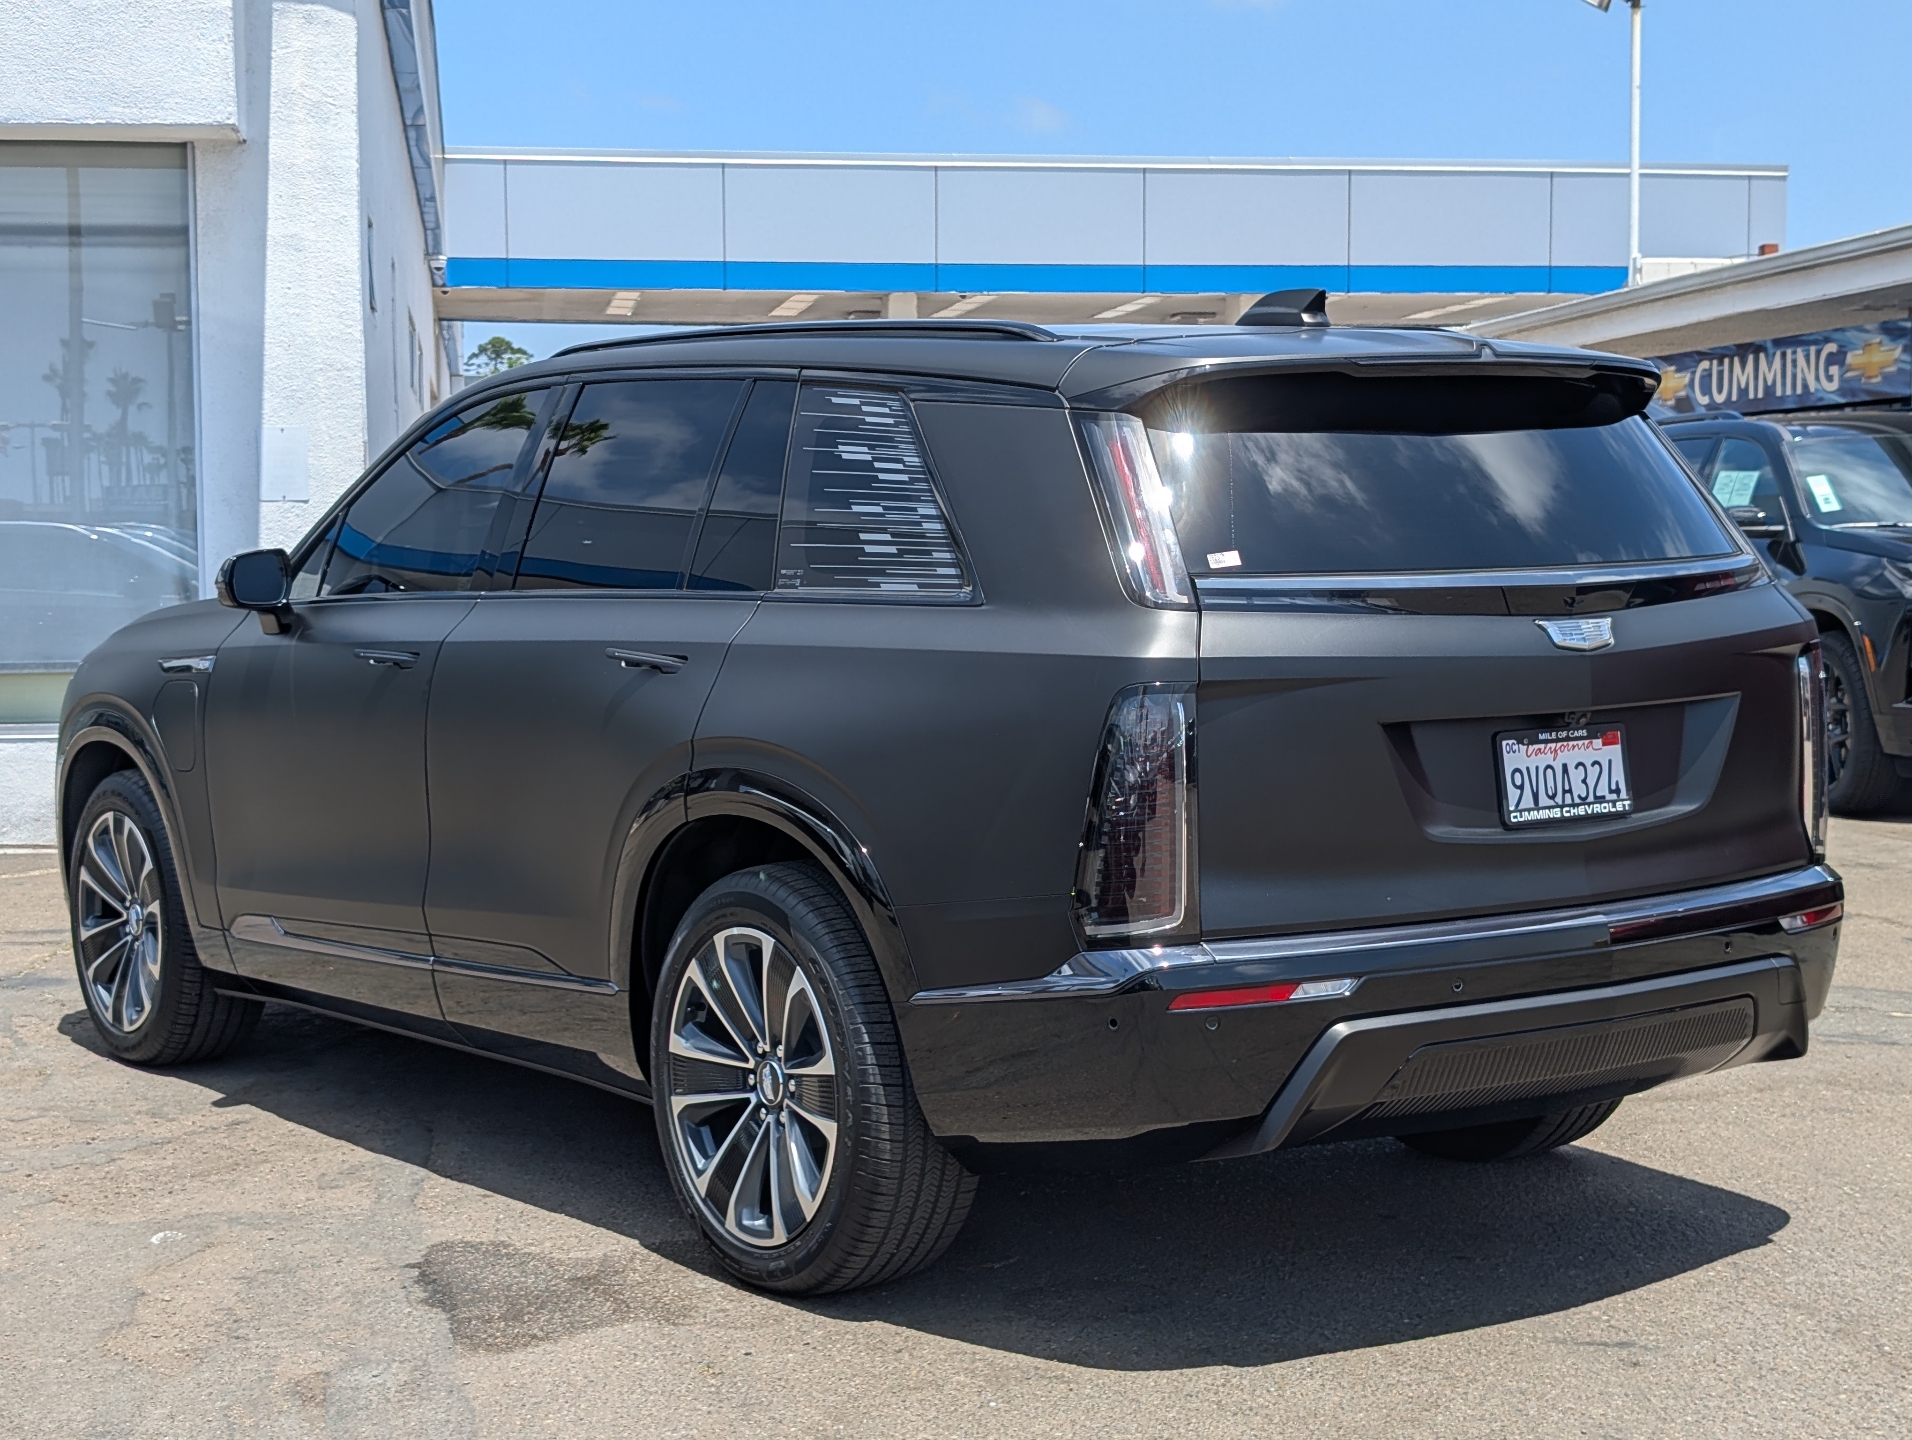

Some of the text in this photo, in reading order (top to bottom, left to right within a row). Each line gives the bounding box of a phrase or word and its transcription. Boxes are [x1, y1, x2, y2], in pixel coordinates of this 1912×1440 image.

[1694, 342, 1839, 405] CUMMING
[1538, 729, 1588, 740] MILE OF CARS
[1505, 741, 1521, 755] OCT
[1510, 758, 1622, 809] 9VQA324
[1510, 800, 1631, 823] CUMMING CHEVROLET
